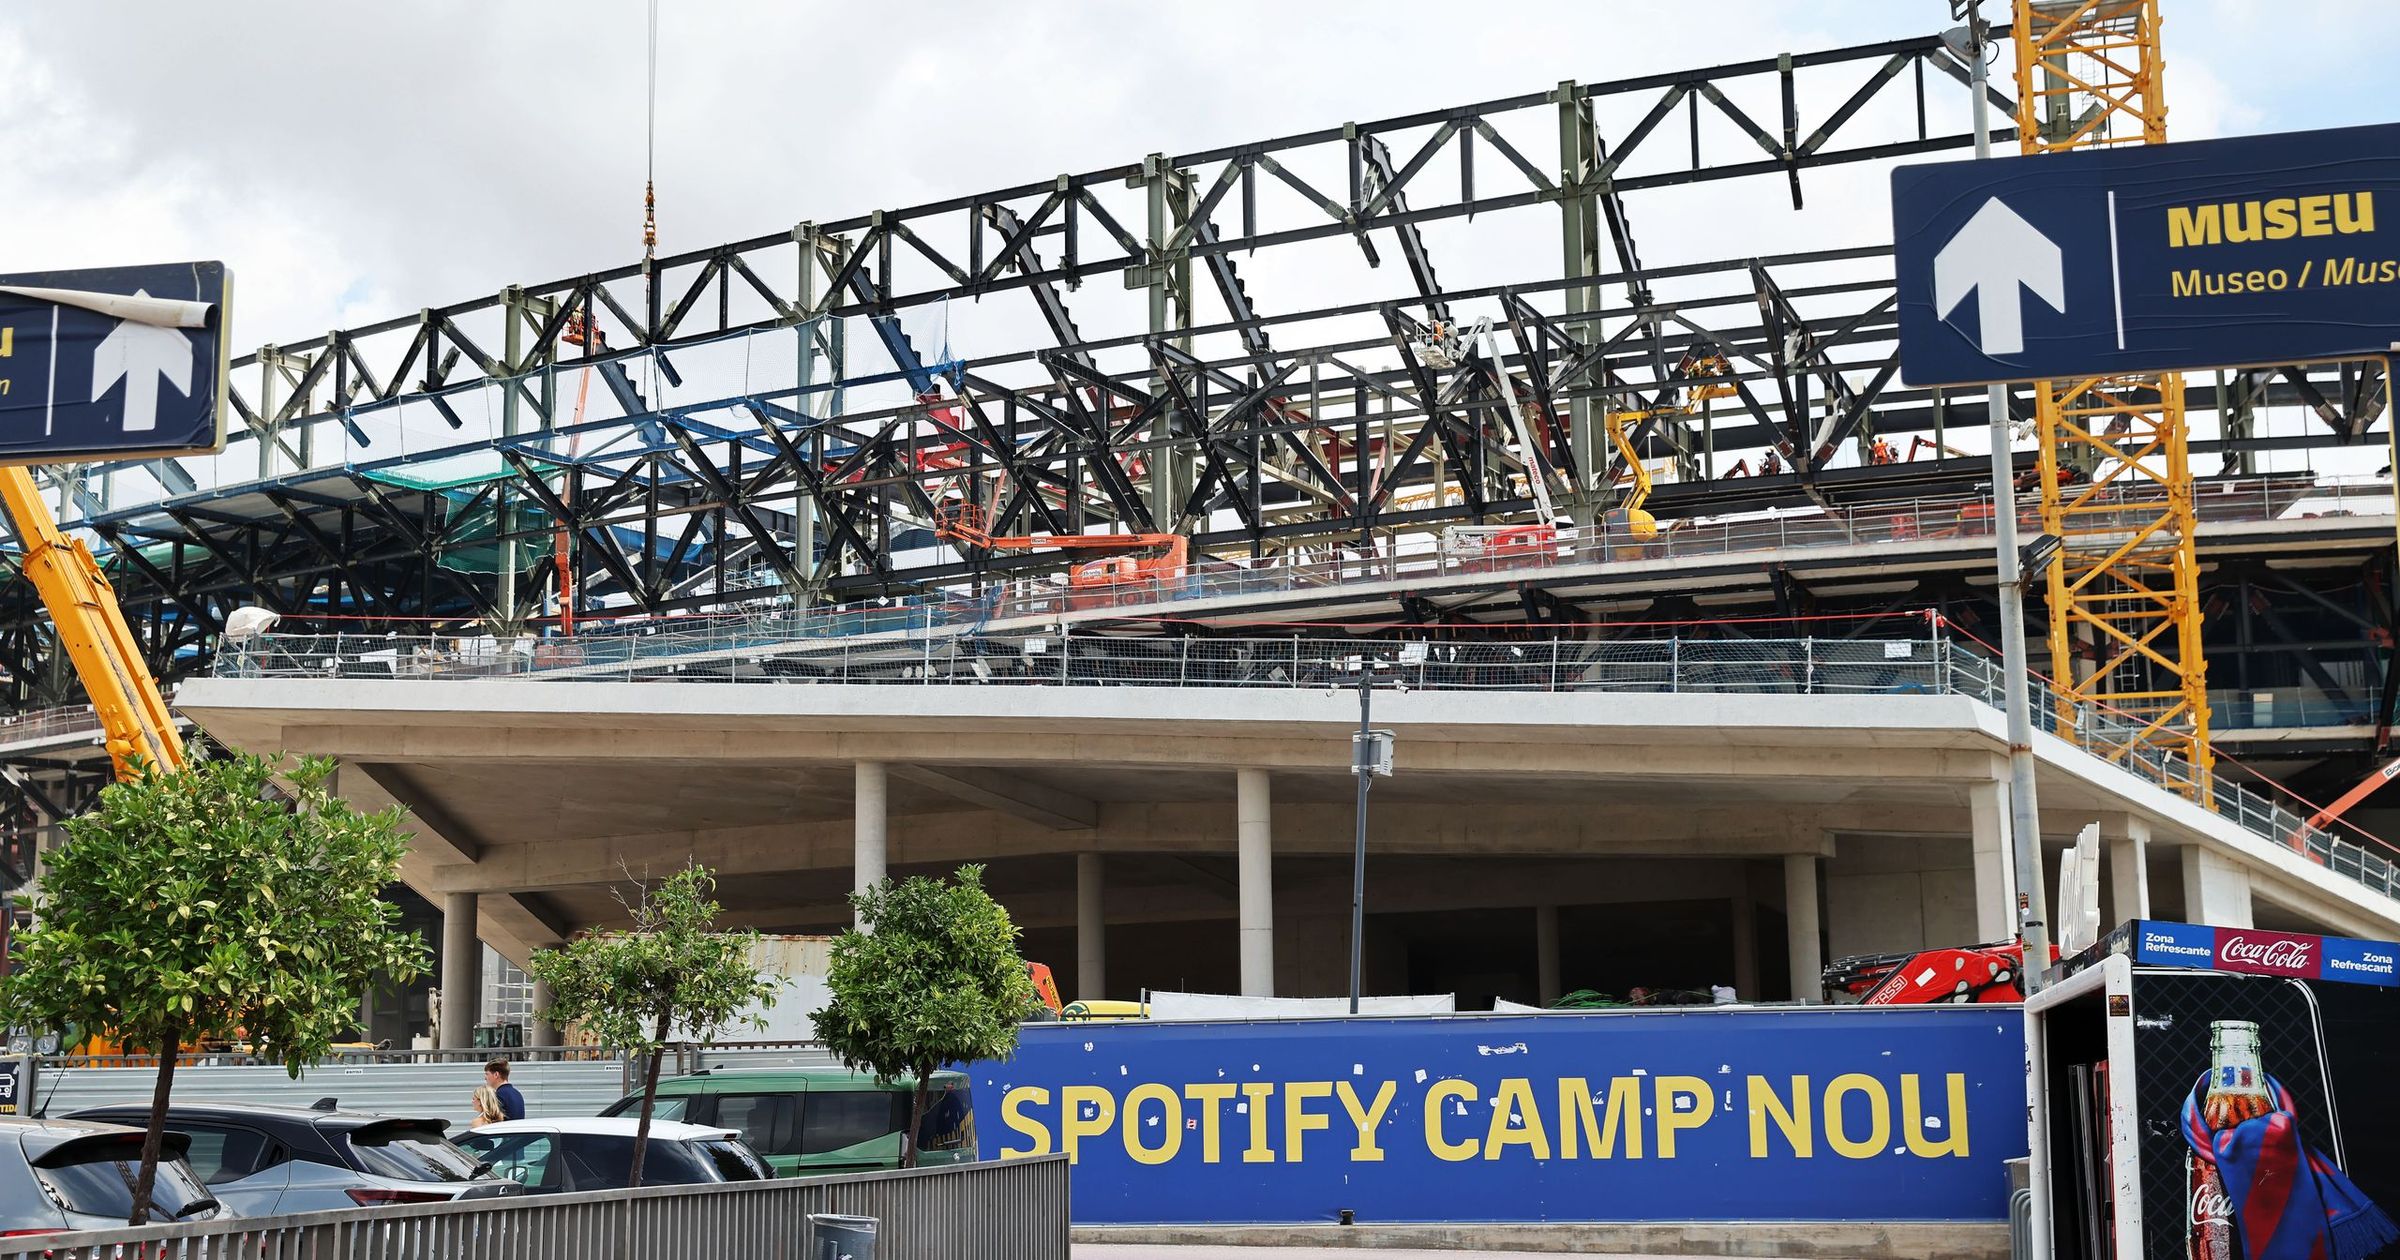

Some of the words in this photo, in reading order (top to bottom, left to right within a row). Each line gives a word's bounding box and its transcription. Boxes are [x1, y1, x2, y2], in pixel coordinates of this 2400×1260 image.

[2171, 269, 2288, 298] Museo
[2297, 260, 2313, 288] /
[2322, 257, 2400, 288] Mus
[2145, 933, 2174, 944] Zona
[2145, 942, 2211, 956] Refrescante
[2221, 936, 2313, 969] Coca-Cola
[2362, 952, 2393, 964] Zona
[2330, 959, 2393, 974] Refrescant
[1000, 1081, 1397, 1165] SPOTIFY
[1424, 1075, 1715, 1161] CAMP
[1747, 1073, 1970, 1160] NOU
